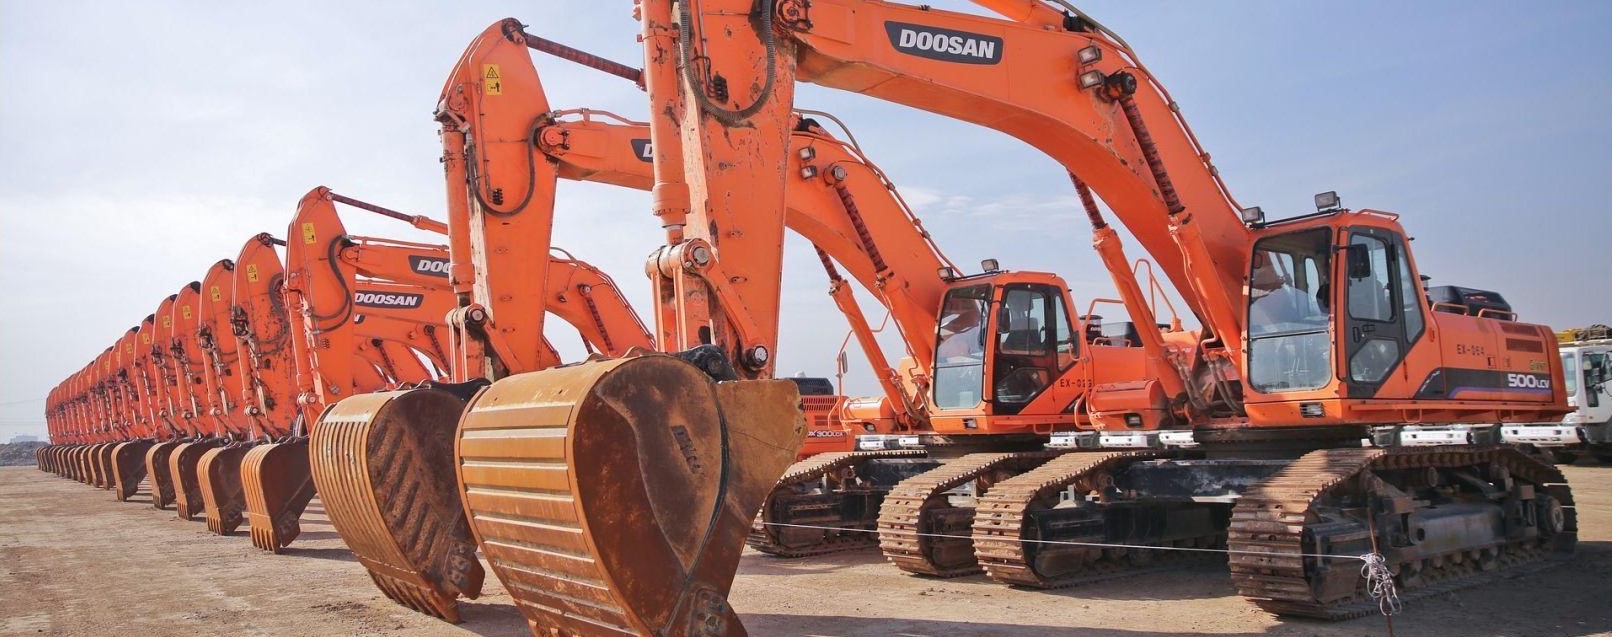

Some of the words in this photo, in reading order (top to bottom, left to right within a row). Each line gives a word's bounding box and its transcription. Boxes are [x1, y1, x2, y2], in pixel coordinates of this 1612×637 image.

[899, 29, 994, 59] DOOSAN
[355, 293, 417, 306] DOOSAN
[1507, 373, 1549, 388] 500LCV
